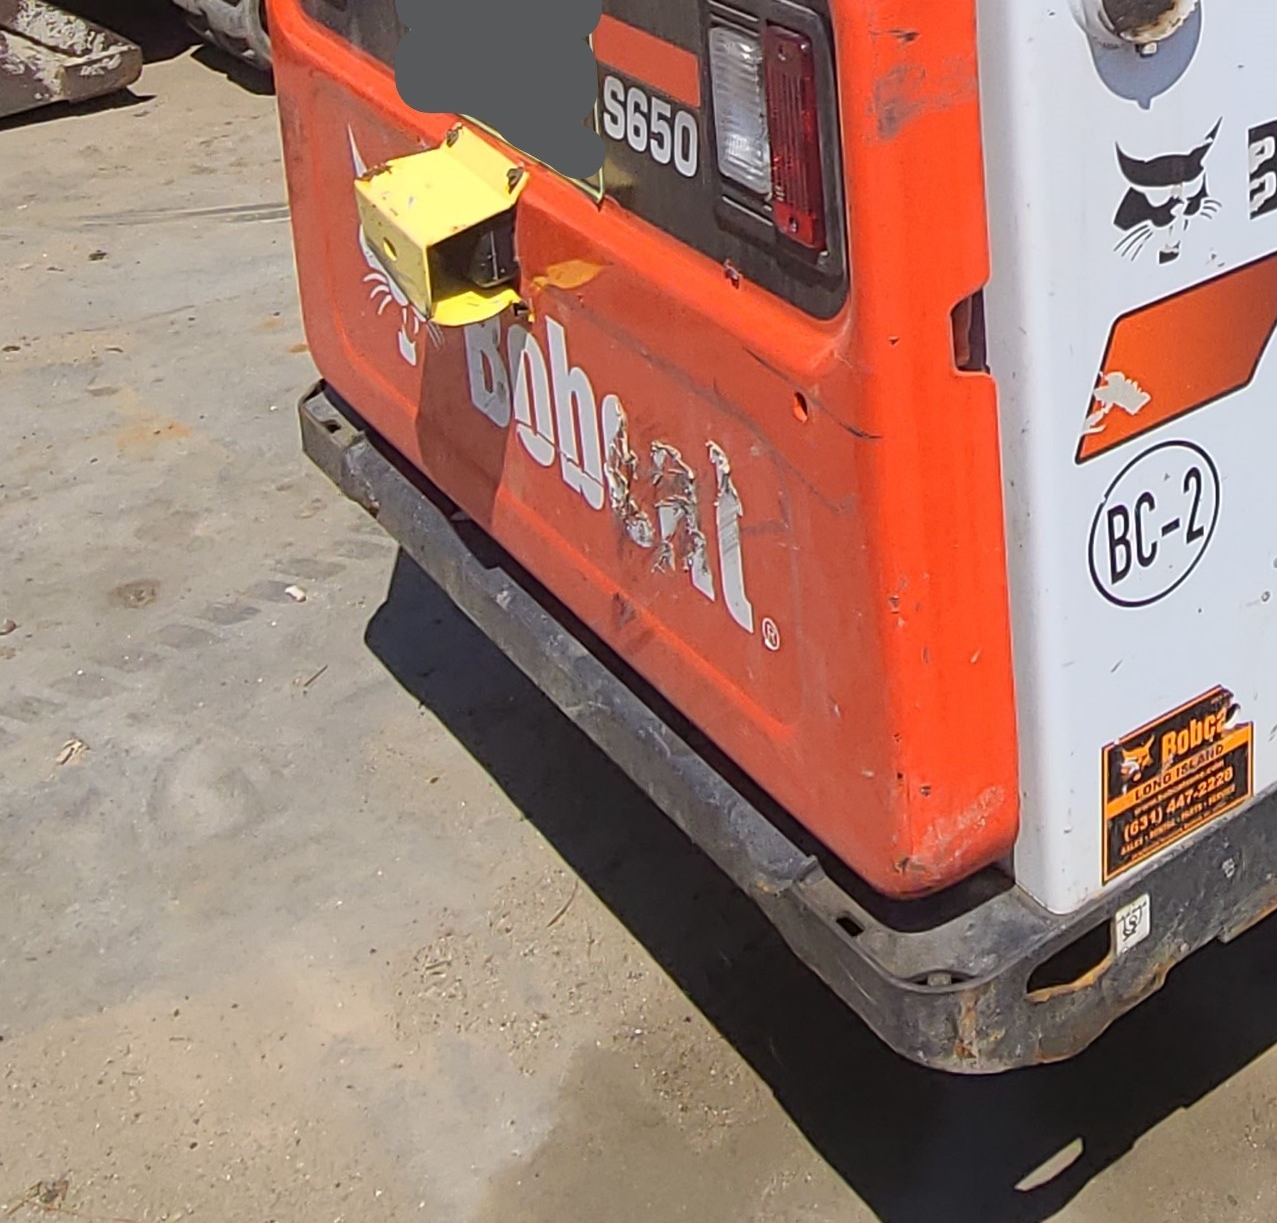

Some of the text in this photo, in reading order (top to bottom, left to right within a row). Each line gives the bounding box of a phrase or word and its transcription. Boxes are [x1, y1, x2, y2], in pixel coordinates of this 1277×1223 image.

[603, 75, 698, 177] S650
[1107, 466, 1205, 585] BC-2
[1161, 707, 1229, 765] Bobca
[1134, 772, 1172, 802] LONG
[1176, 743, 1224, 776] ISLAND
[1124, 807, 1163, 842] (631)
